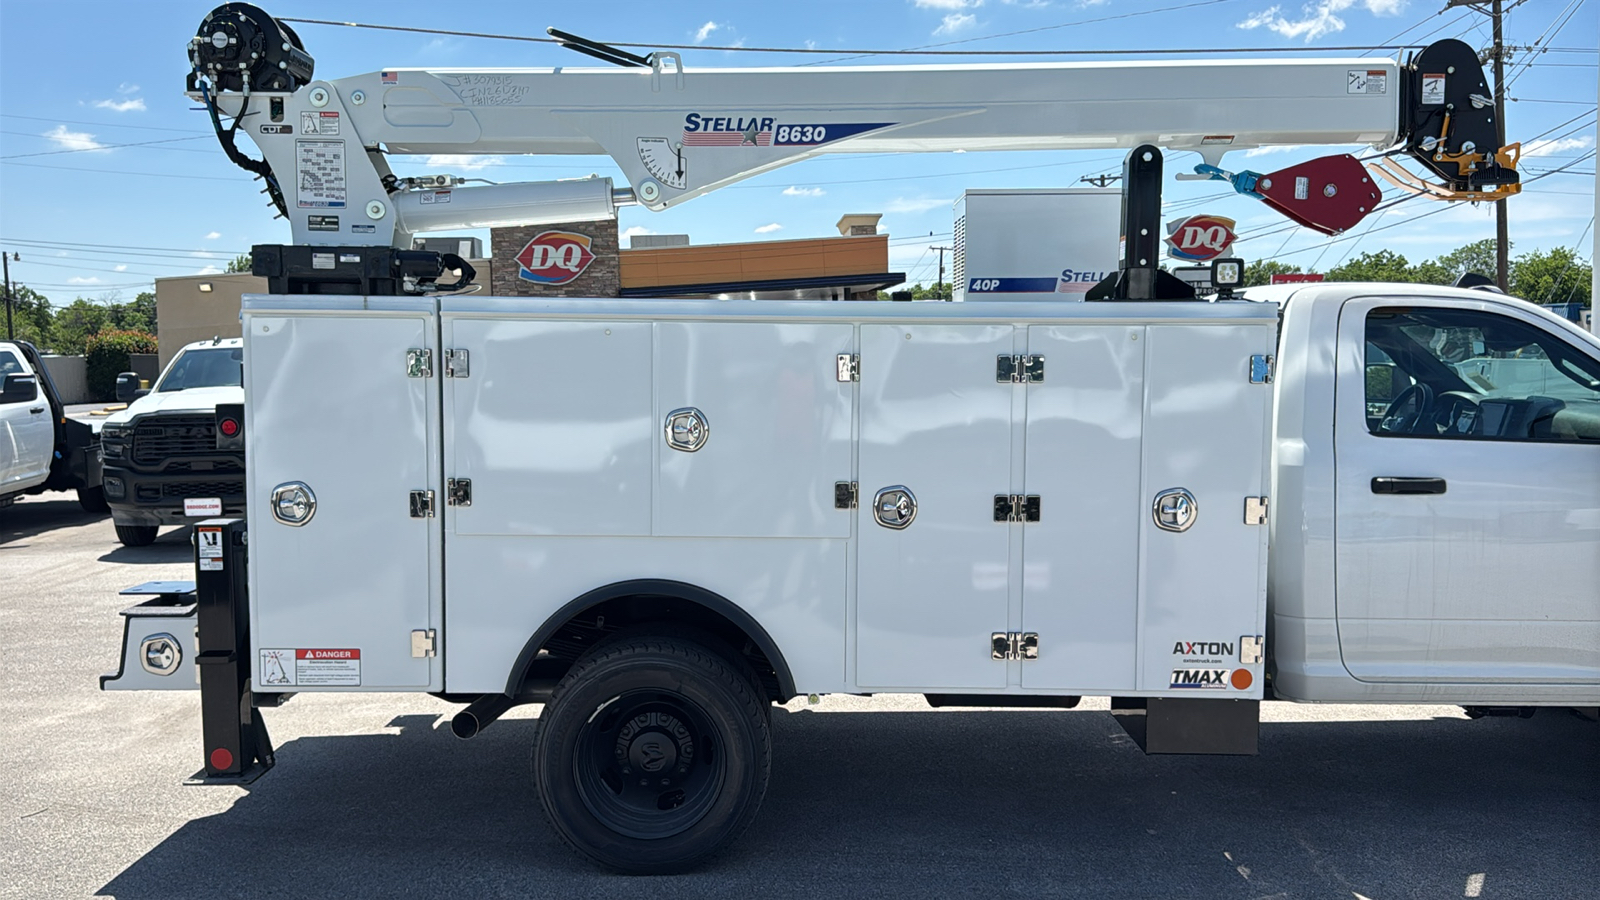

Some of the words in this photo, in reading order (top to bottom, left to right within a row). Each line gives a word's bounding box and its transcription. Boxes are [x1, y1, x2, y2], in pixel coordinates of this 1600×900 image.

[684, 113, 774, 132] STELLAR
[777, 126, 827, 142] 8630
[1180, 226, 1228, 252] DQ
[530, 243, 582, 272] DQ
[972, 279, 1000, 292] 40P
[1173, 642, 1234, 655] AXTON
[1173, 670, 1226, 684] TMAX
